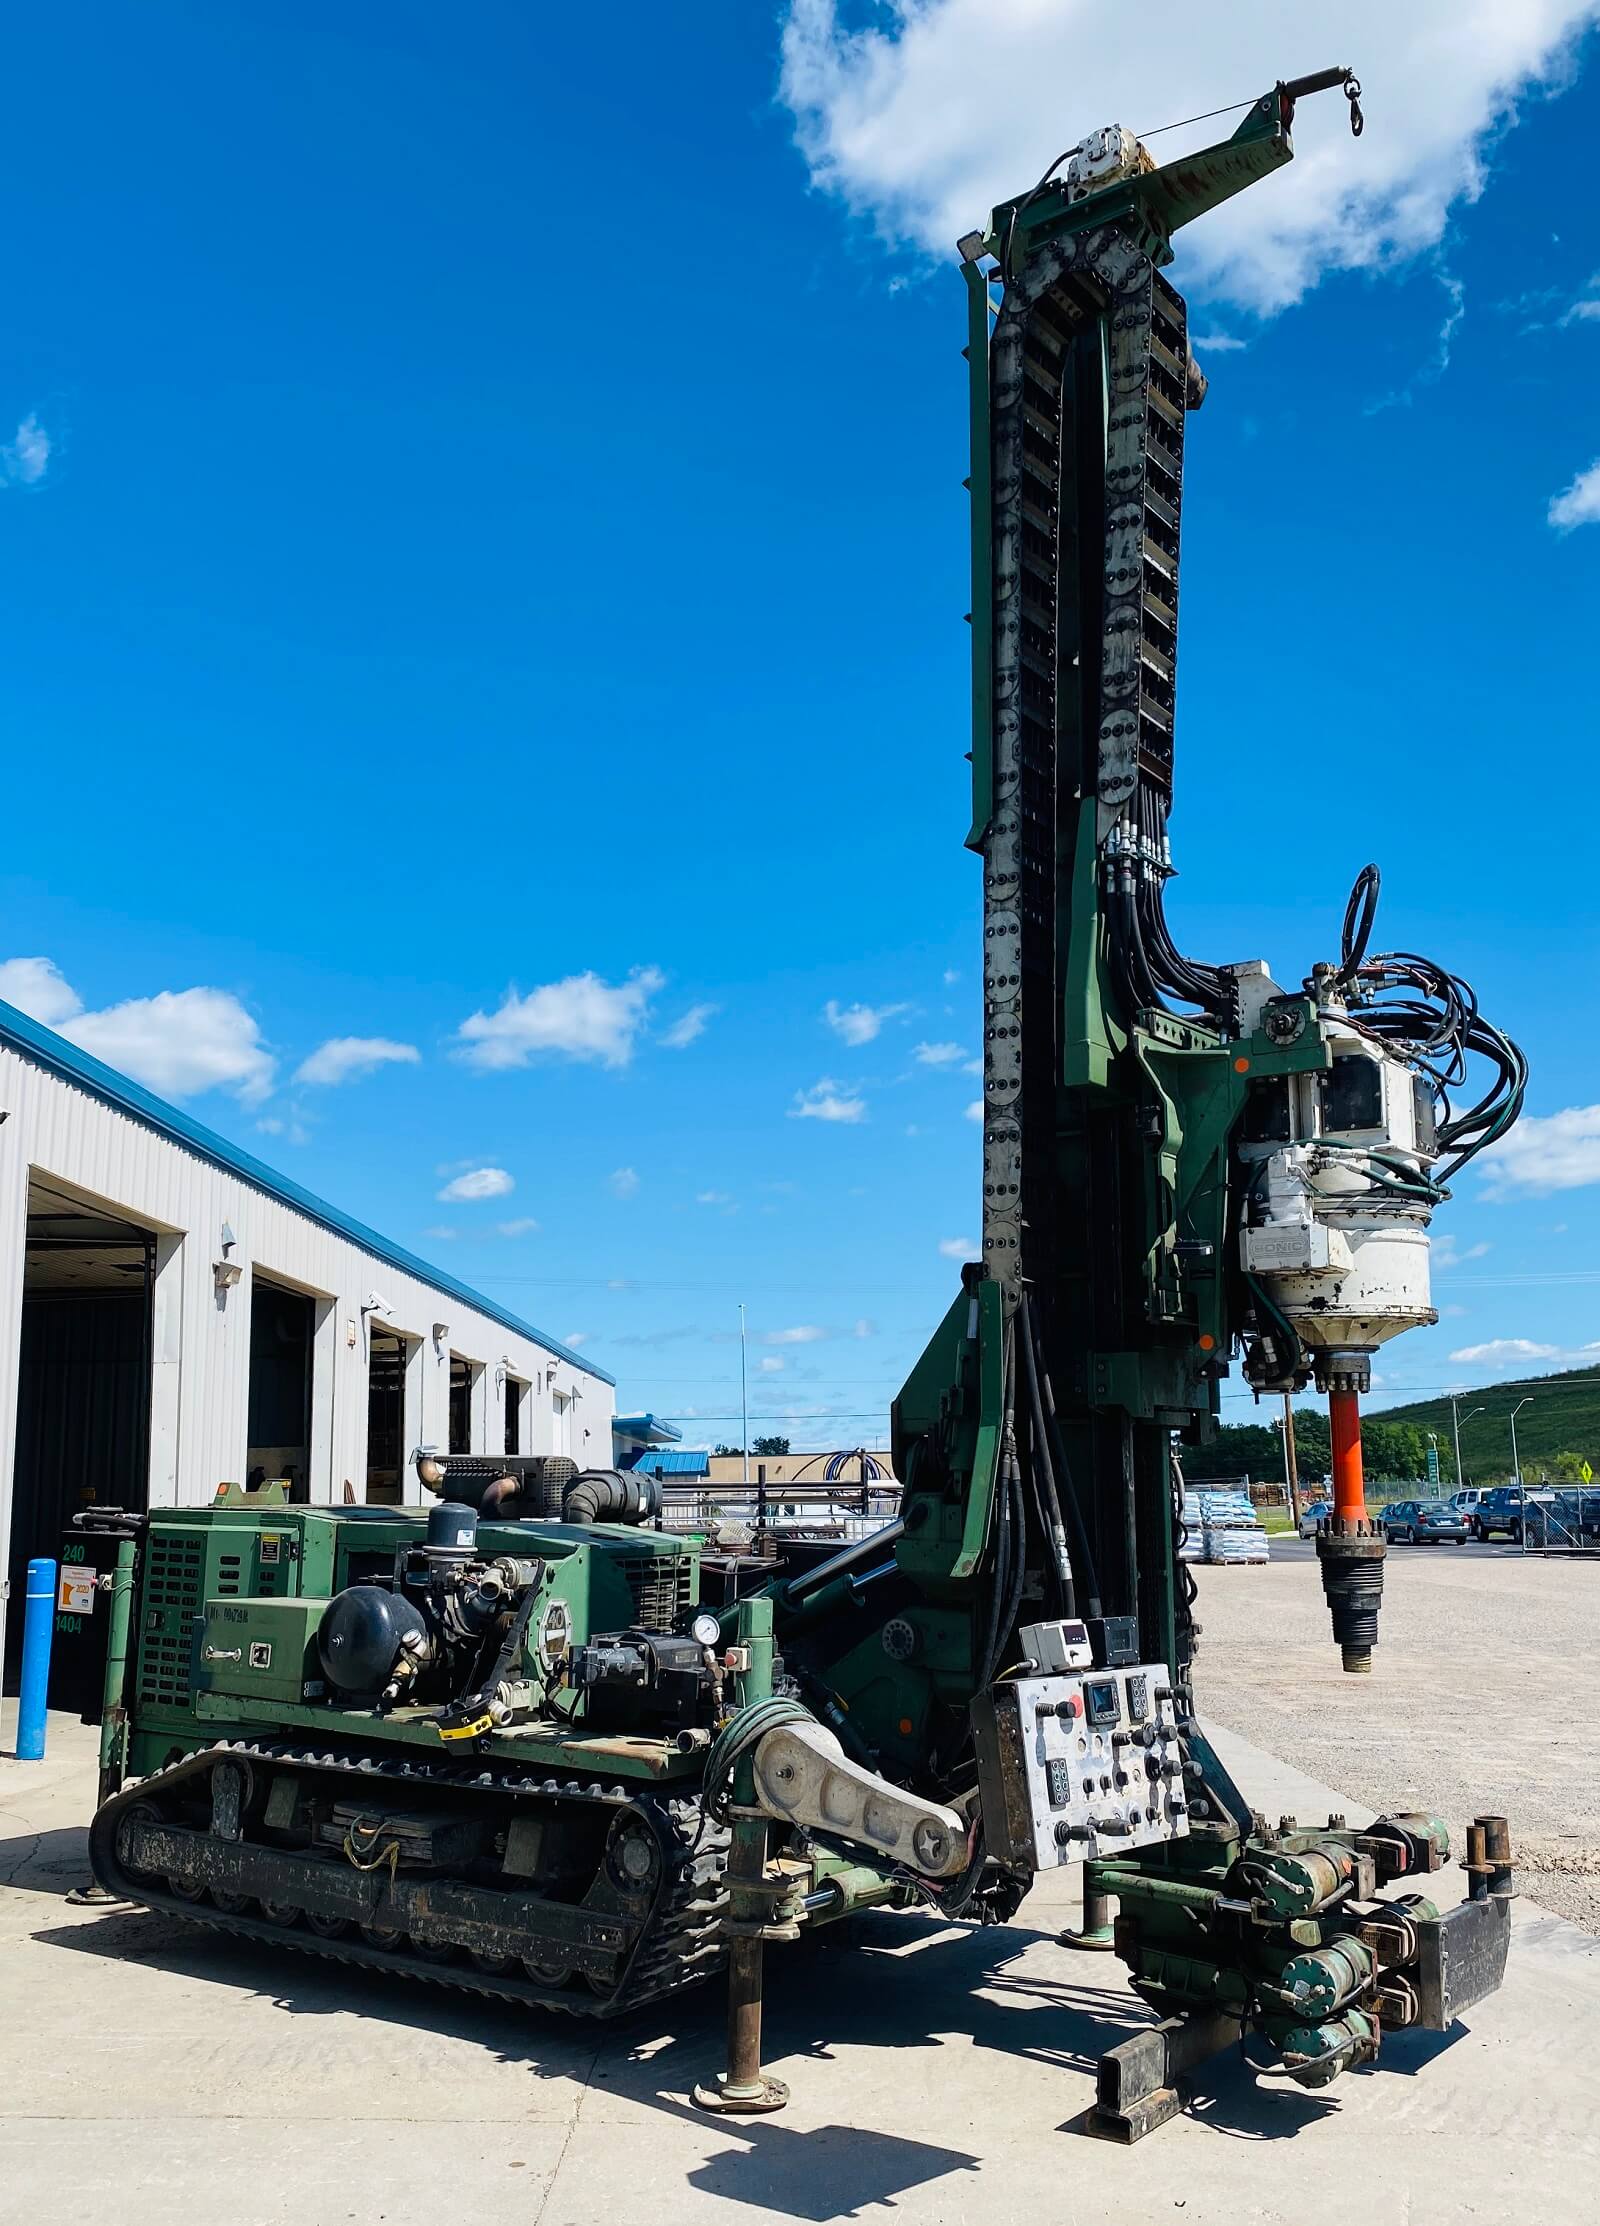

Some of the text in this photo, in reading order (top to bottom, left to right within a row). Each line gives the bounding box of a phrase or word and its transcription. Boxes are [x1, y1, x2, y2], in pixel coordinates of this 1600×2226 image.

[63, 1544, 85, 1561] 240
[56, 1615, 82, 1634] 1404
[548, 1610, 564, 1629] 40
